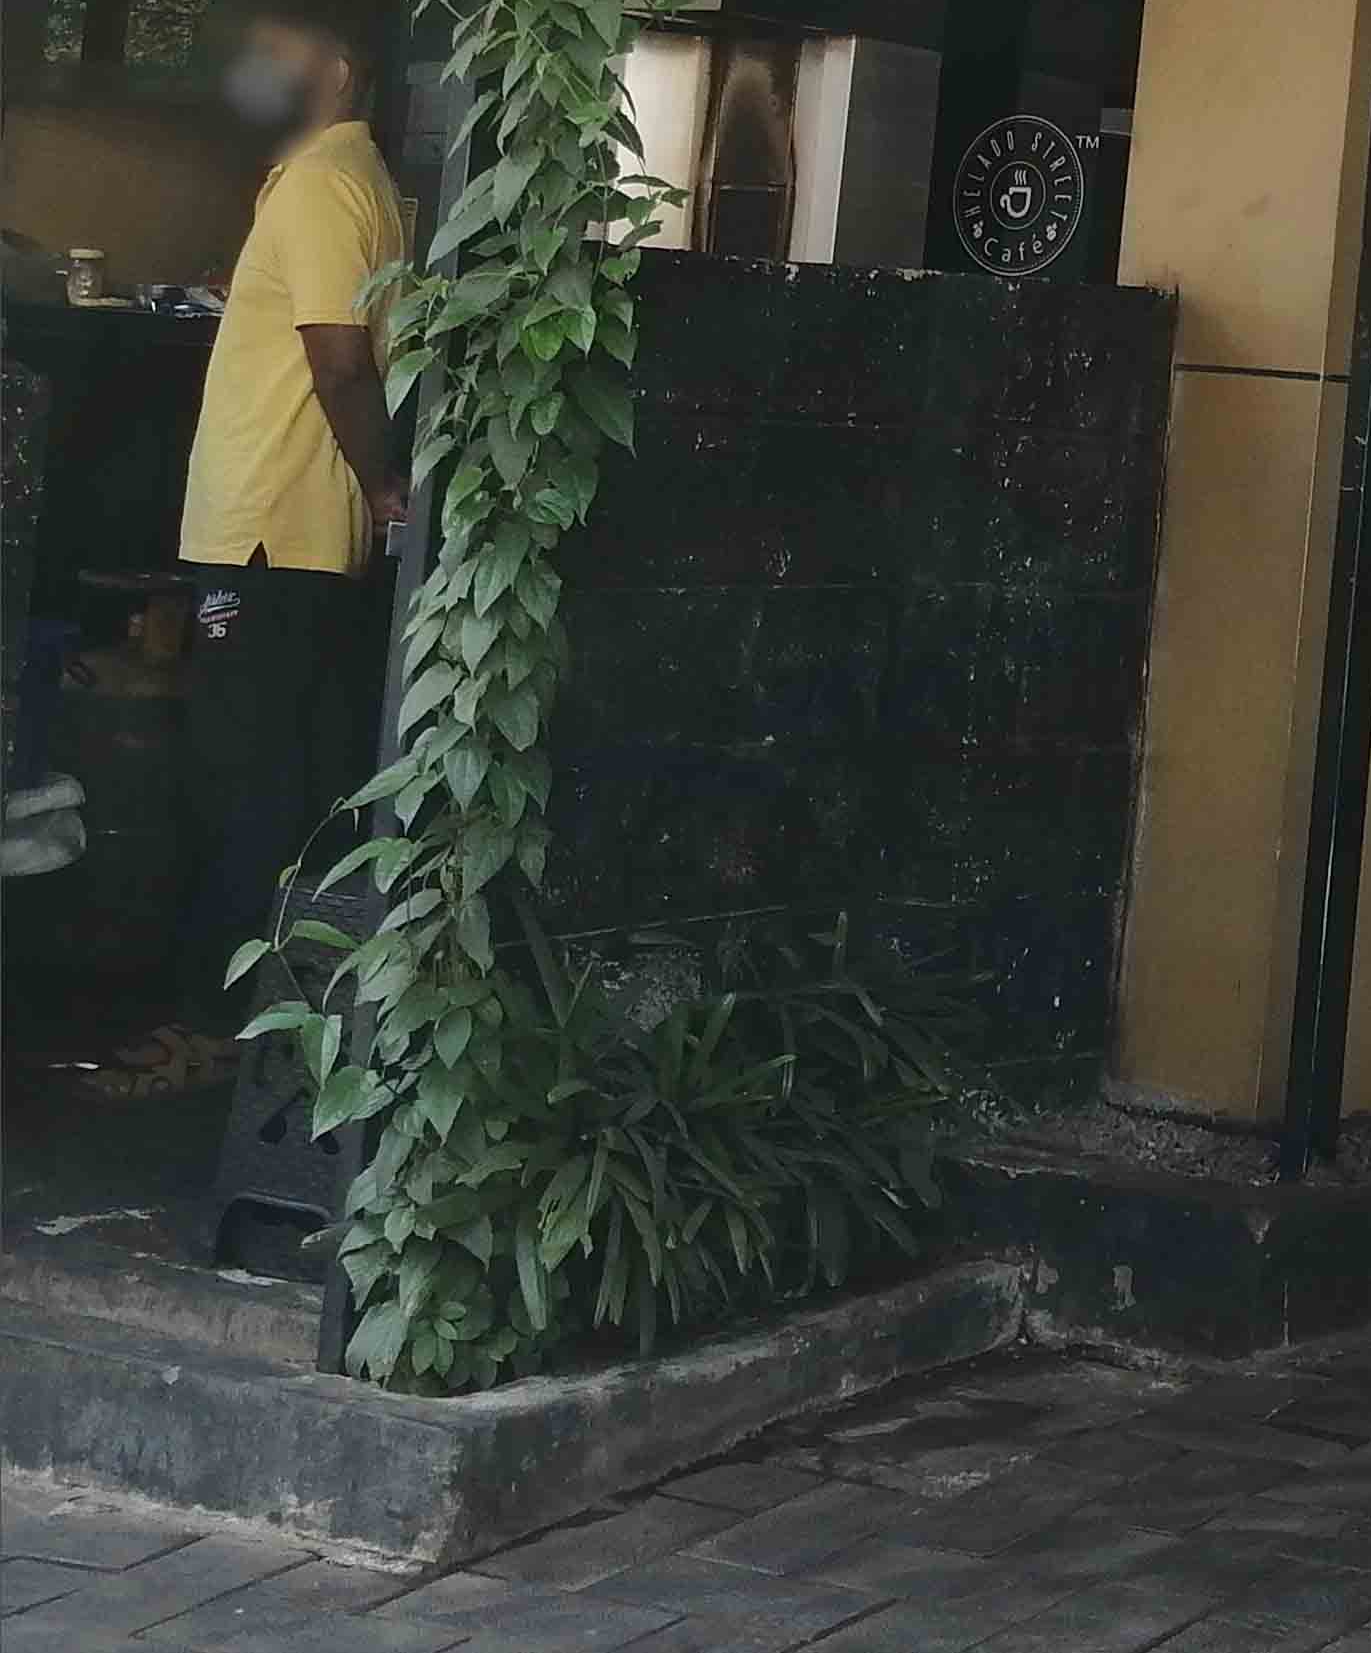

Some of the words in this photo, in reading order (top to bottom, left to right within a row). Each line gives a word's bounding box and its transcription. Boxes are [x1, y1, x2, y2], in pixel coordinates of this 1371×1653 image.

[1075, 135, 1101, 149] TM
[962, 130, 1016, 219] HELADO
[1031, 130, 1073, 222] STREET
[983, 232, 1044, 263] Café
